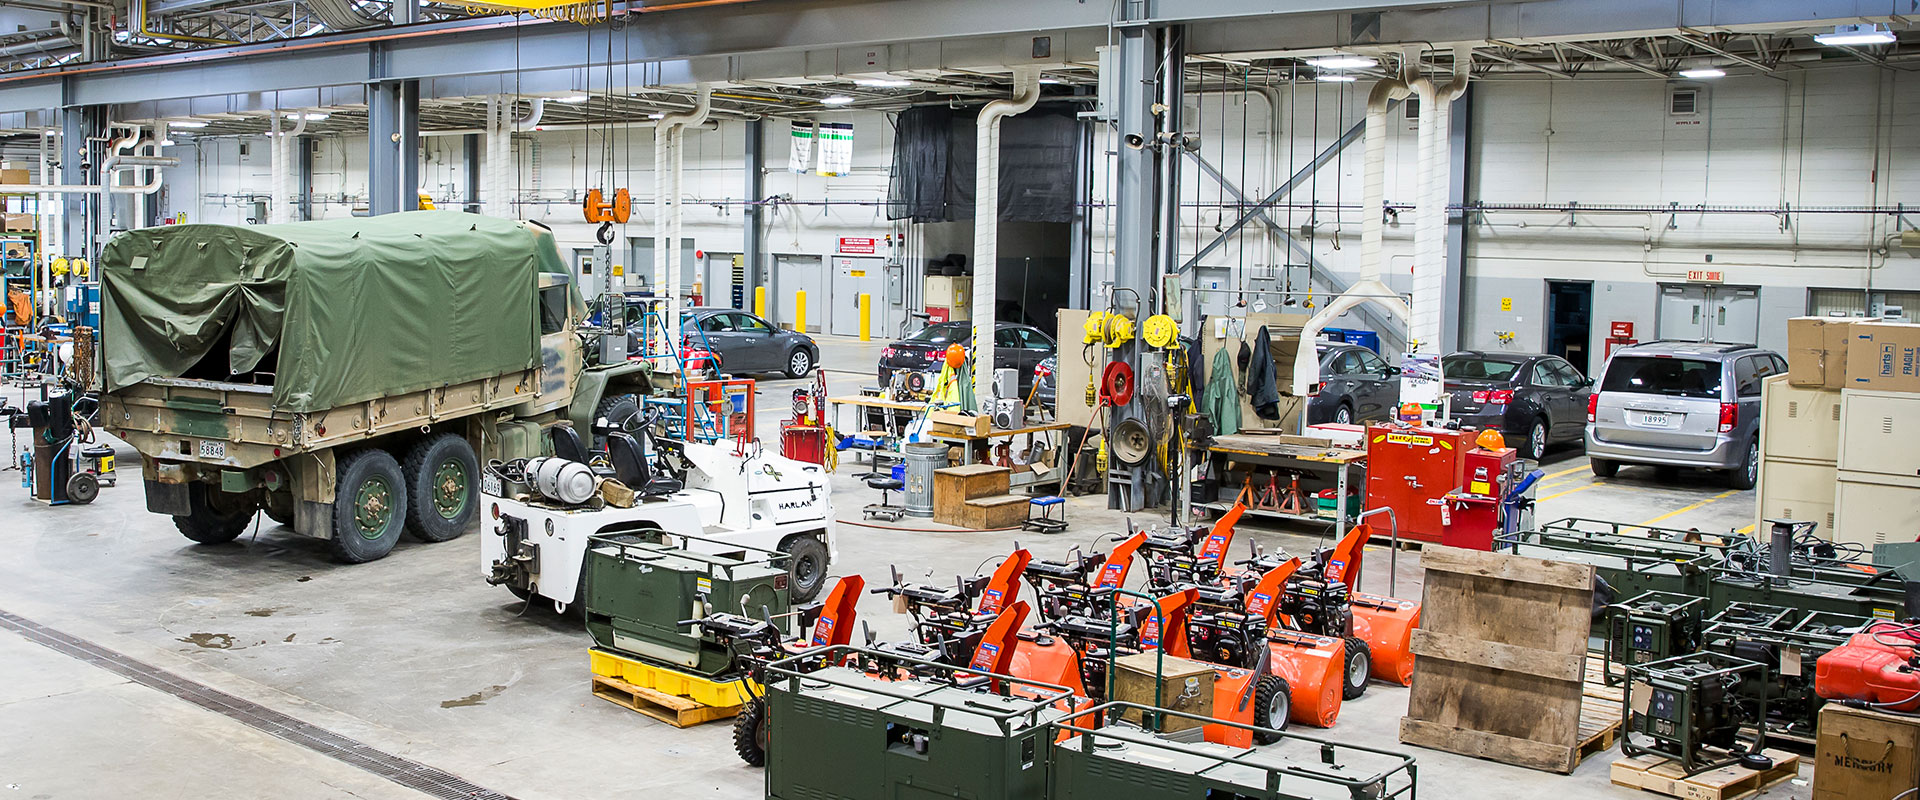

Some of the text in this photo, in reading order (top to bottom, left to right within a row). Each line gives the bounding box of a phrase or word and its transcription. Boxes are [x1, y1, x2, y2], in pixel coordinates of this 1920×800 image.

[1688, 271, 1703, 280] EXIT
[1881, 353, 1891, 375] harts
[1903, 347, 1914, 376] FRAGILE
[1644, 415, 1667, 424] 18995
[200, 445, 224, 457] 58848
[778, 500, 812, 510] HARLAN
[1834, 754, 1894, 774] MERCURY
